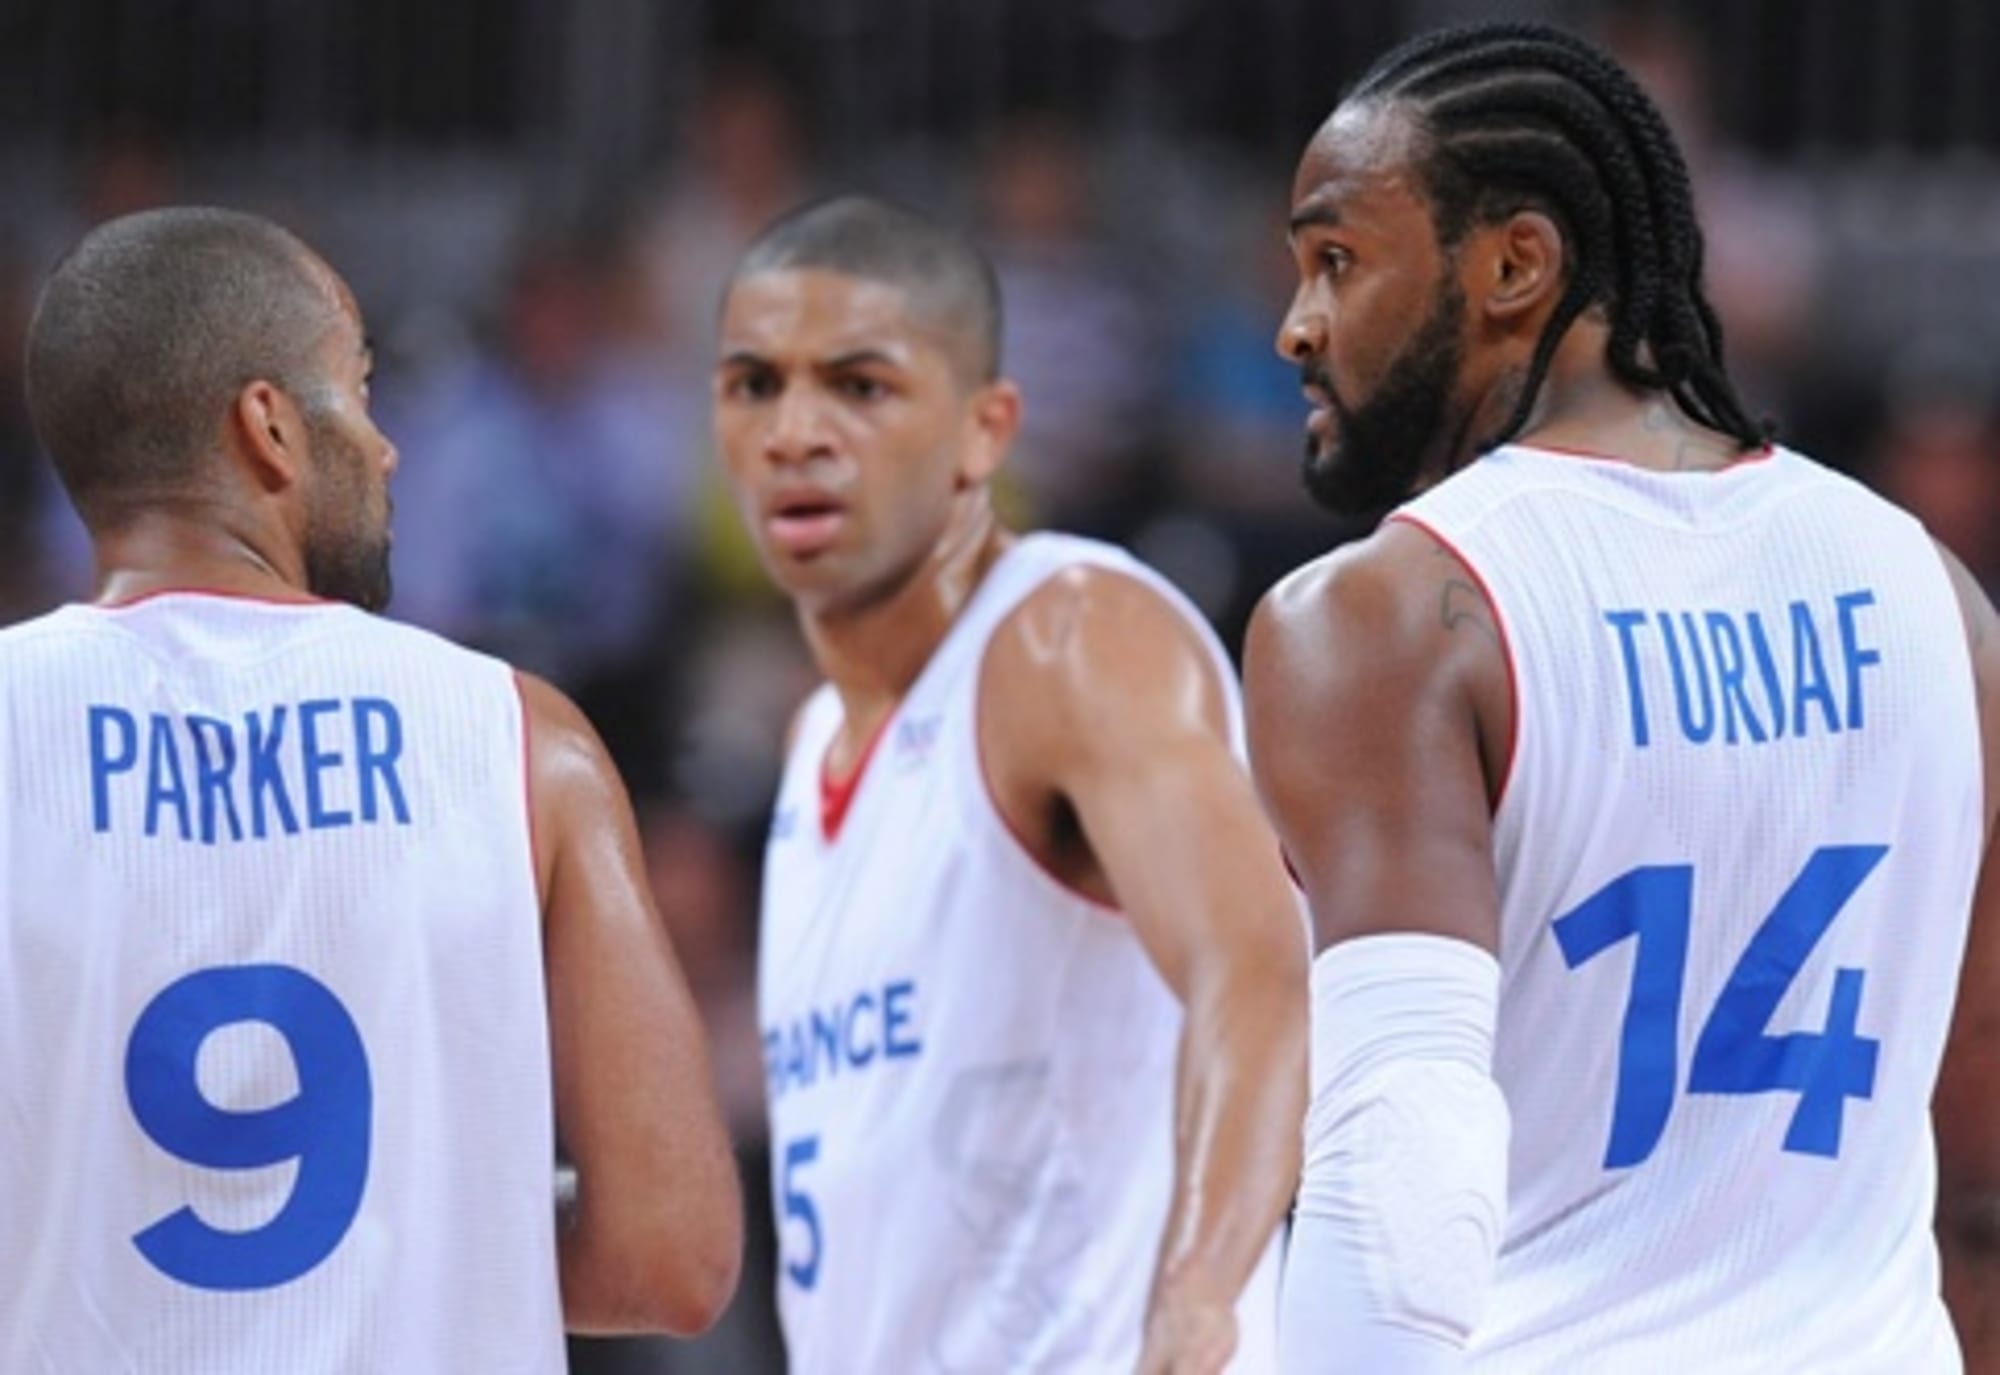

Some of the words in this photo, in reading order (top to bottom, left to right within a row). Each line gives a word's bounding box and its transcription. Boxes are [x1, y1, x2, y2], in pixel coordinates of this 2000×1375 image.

[1605, 589, 1881, 748] TURIAF
[87, 696, 411, 845] PARKER
[764, 980, 922, 1094] RANCE
[1551, 843, 1891, 1170] 14
[124, 963, 373, 1292] 9
[783, 1135, 822, 1290] 5
